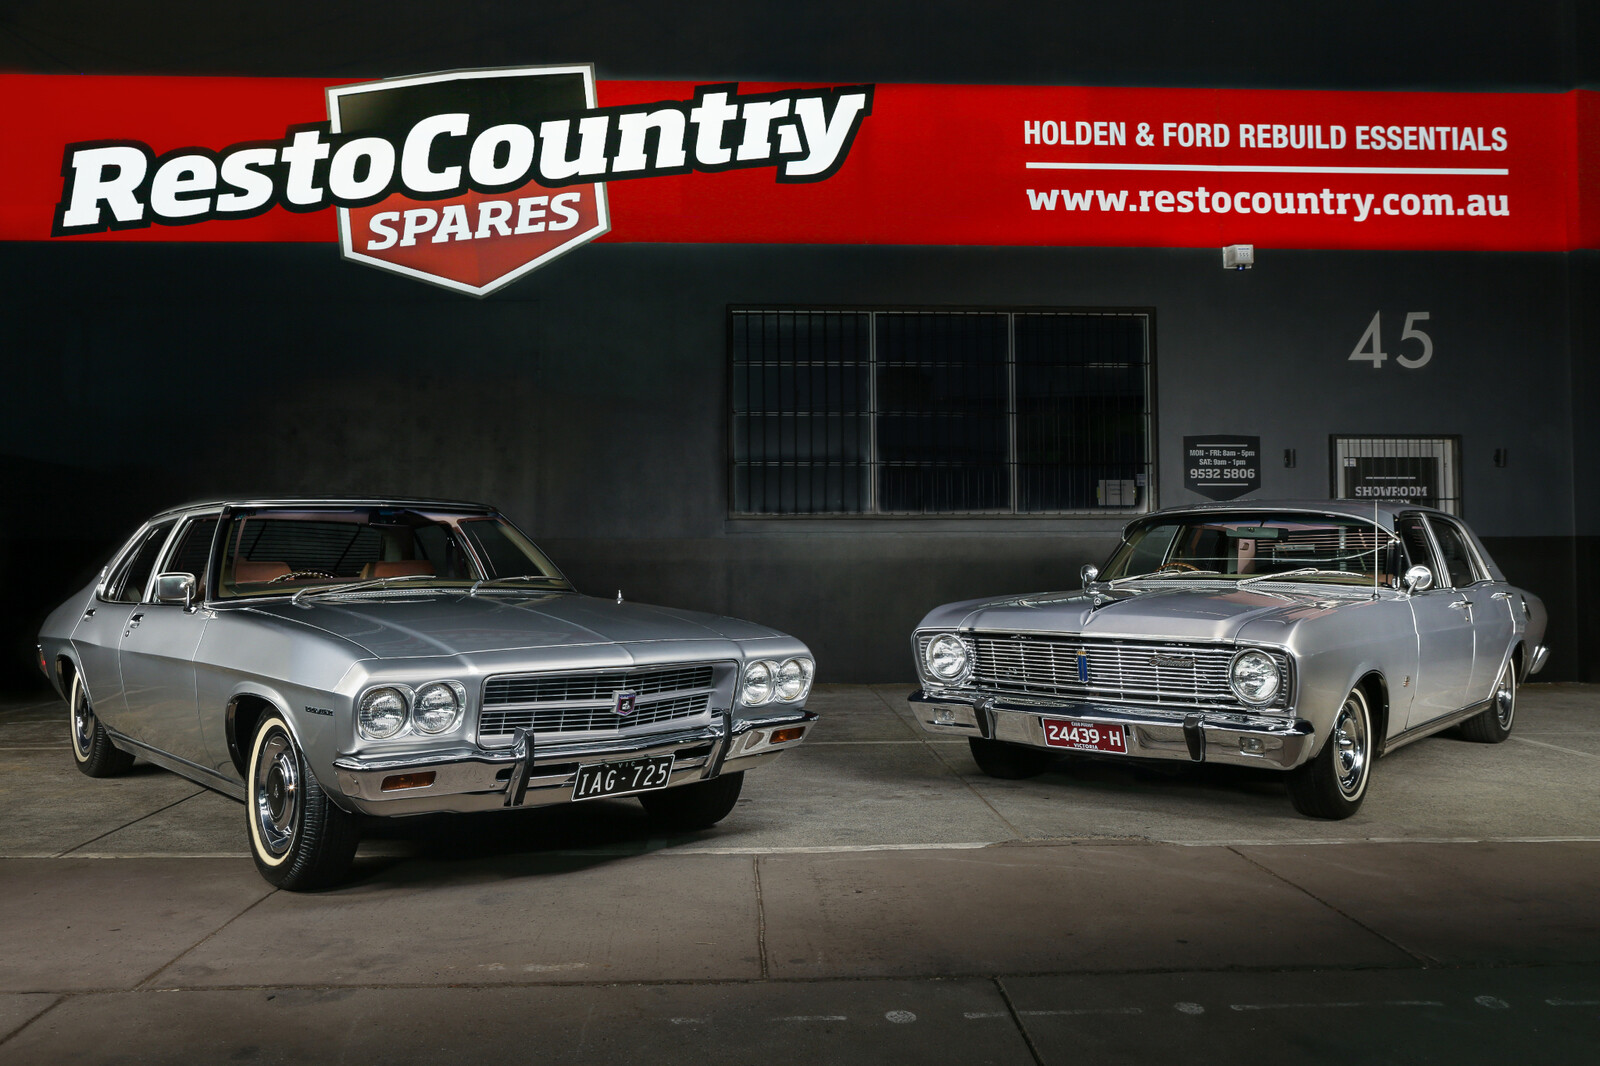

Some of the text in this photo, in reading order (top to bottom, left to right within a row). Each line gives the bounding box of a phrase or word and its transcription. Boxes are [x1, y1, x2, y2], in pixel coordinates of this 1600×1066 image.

[1024, 120, 1508, 152] HOLDEN & FORD REBUILD ESSENTIALS
[62, 92, 866, 228] RestoCountry
[1026, 187, 1510, 222] www.restocountry.com.au
[367, 192, 581, 250] SPARES
[1348, 310, 1433, 369] 45
[1189, 449, 1204, 457] MON
[1209, 449, 1222, 457] FRI:
[1222, 449, 1236, 457] 8am
[1241, 449, 1255, 458] 5pm
[1199, 458, 1213, 466] SAT:
[1213, 458, 1227, 466] 9am
[1232, 458, 1246, 467] 1pm
[1190, 468, 1256, 479] 9532 5806
[1355, 485, 1428, 497] SHOWROOM
